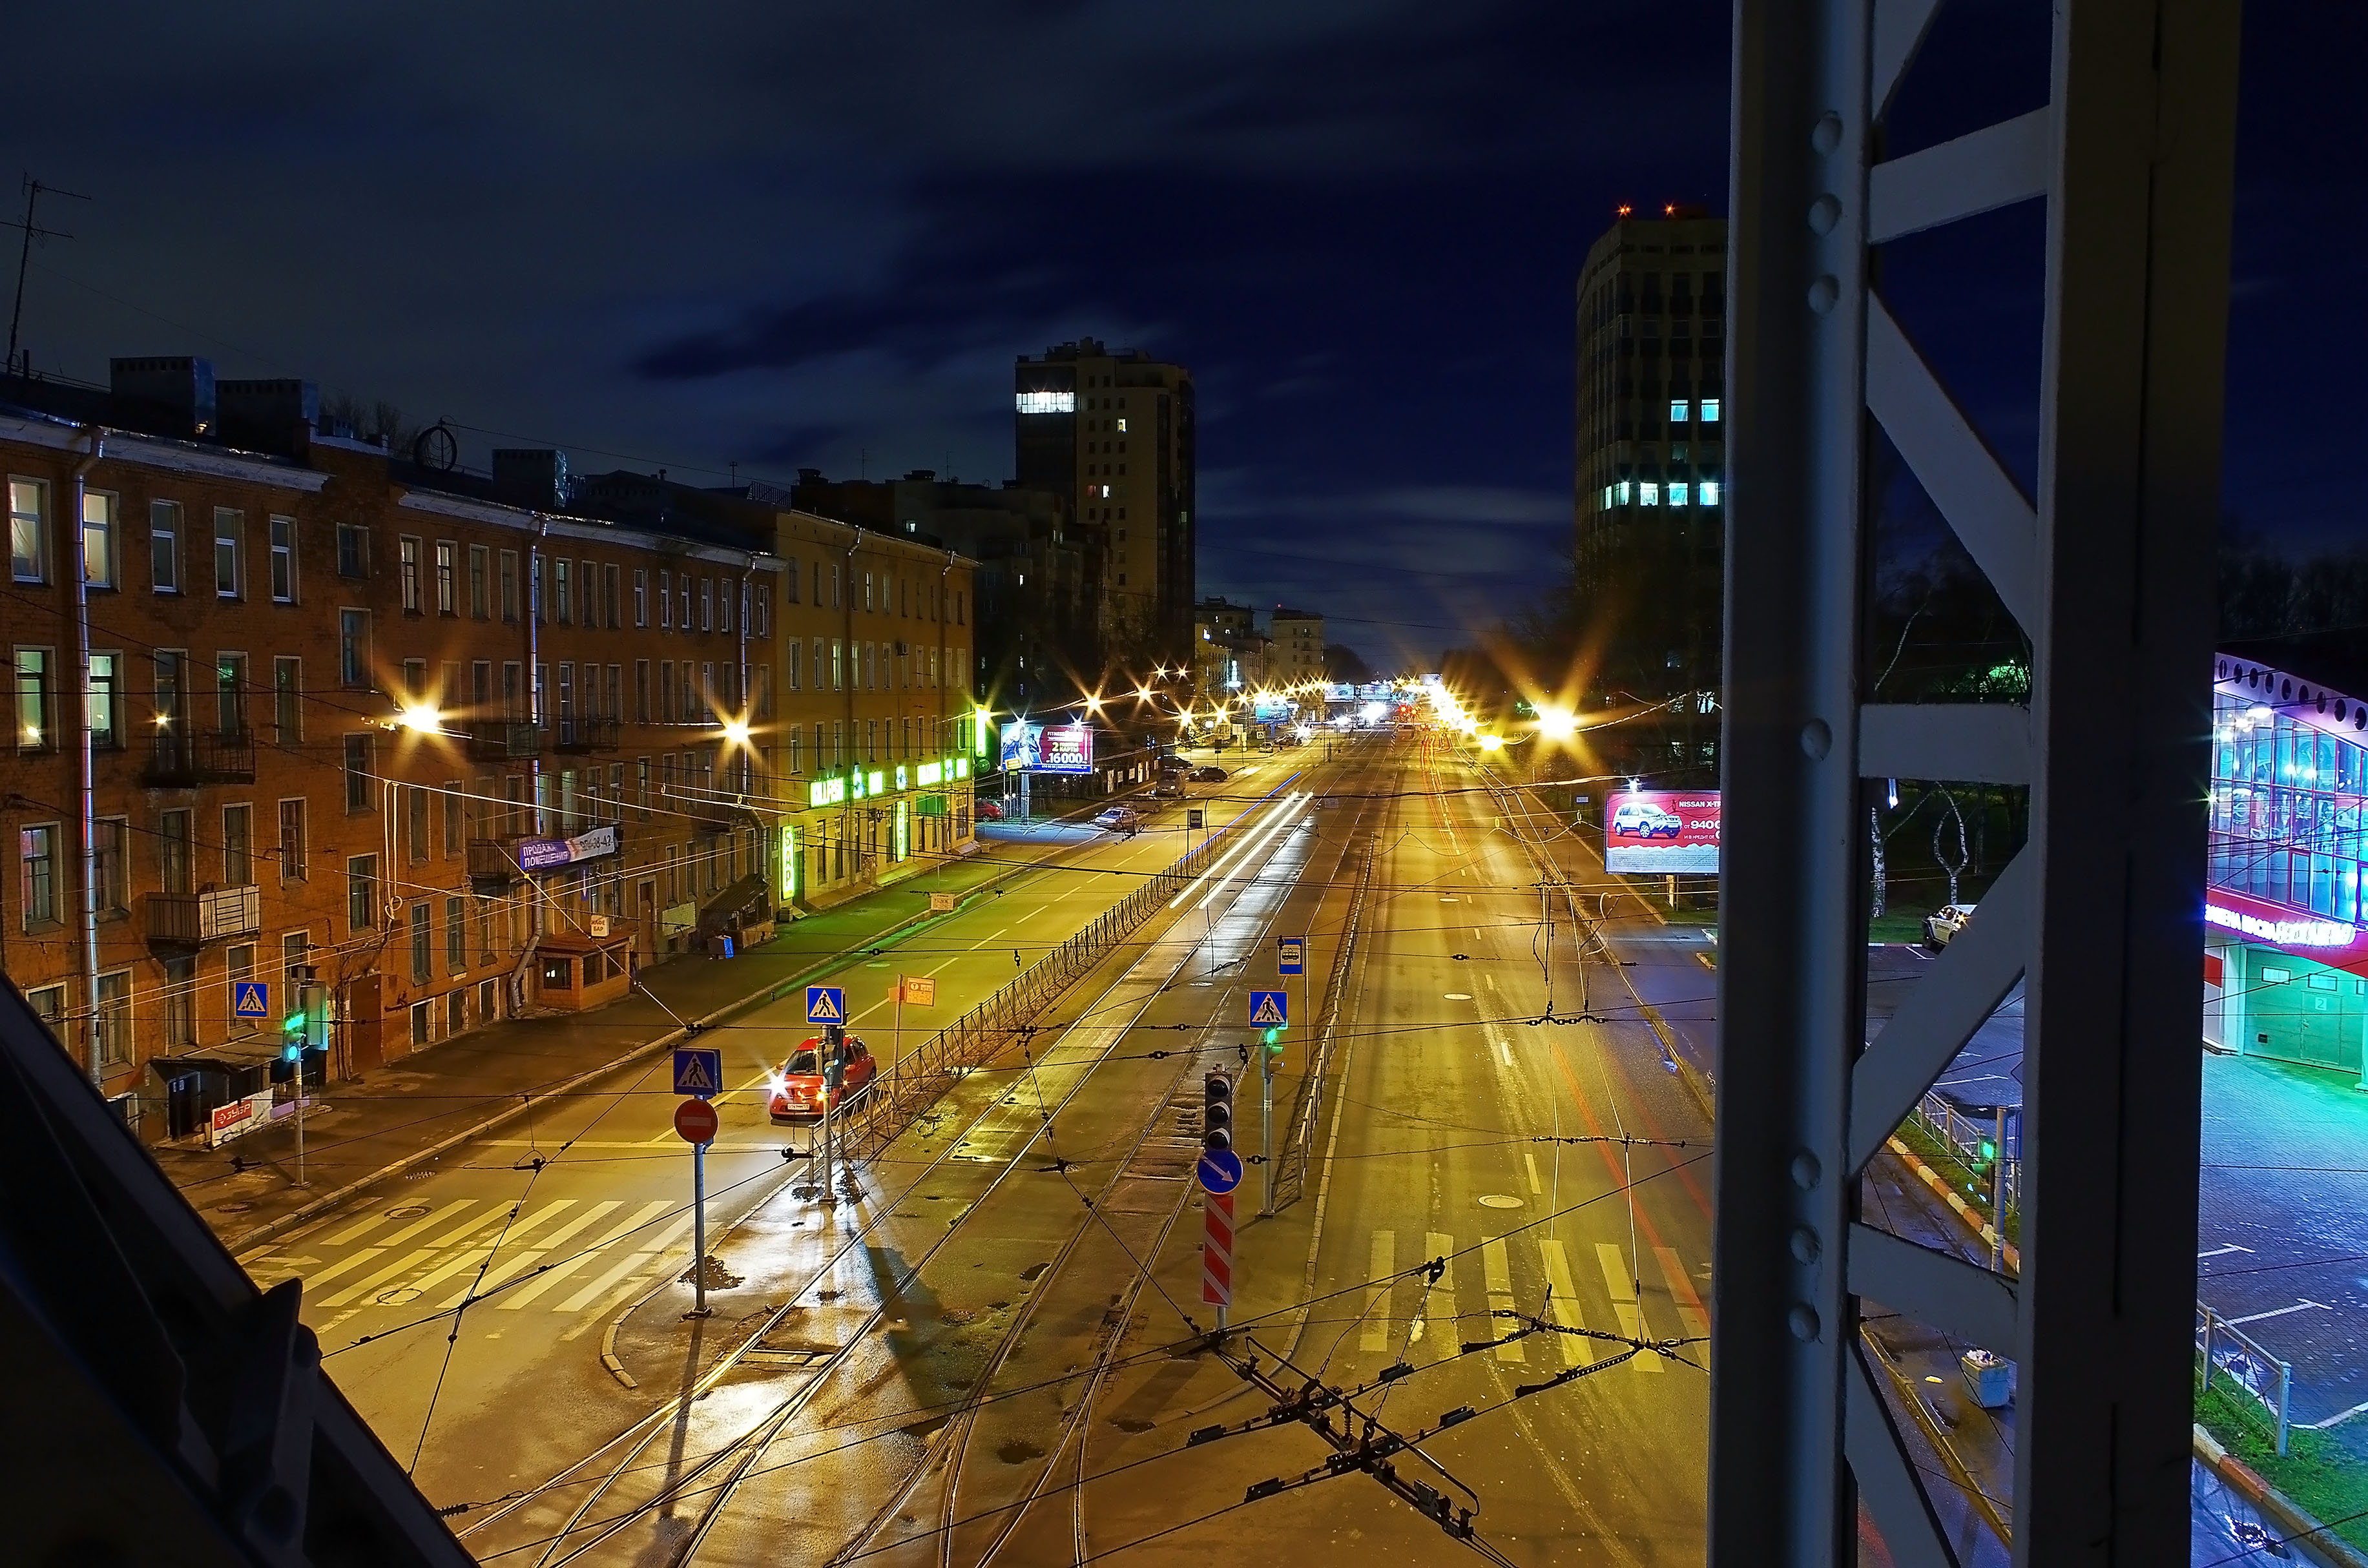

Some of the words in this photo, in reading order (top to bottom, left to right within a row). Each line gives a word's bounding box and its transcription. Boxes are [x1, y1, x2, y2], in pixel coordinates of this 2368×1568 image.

[1052, 742, 1059, 752] 2
[524, 851, 568, 868] ПОМЕЩЕНИЯ
[2318, 998, 2325, 1009] 2
[226, 1103, 251, 1120] ЗУБР
